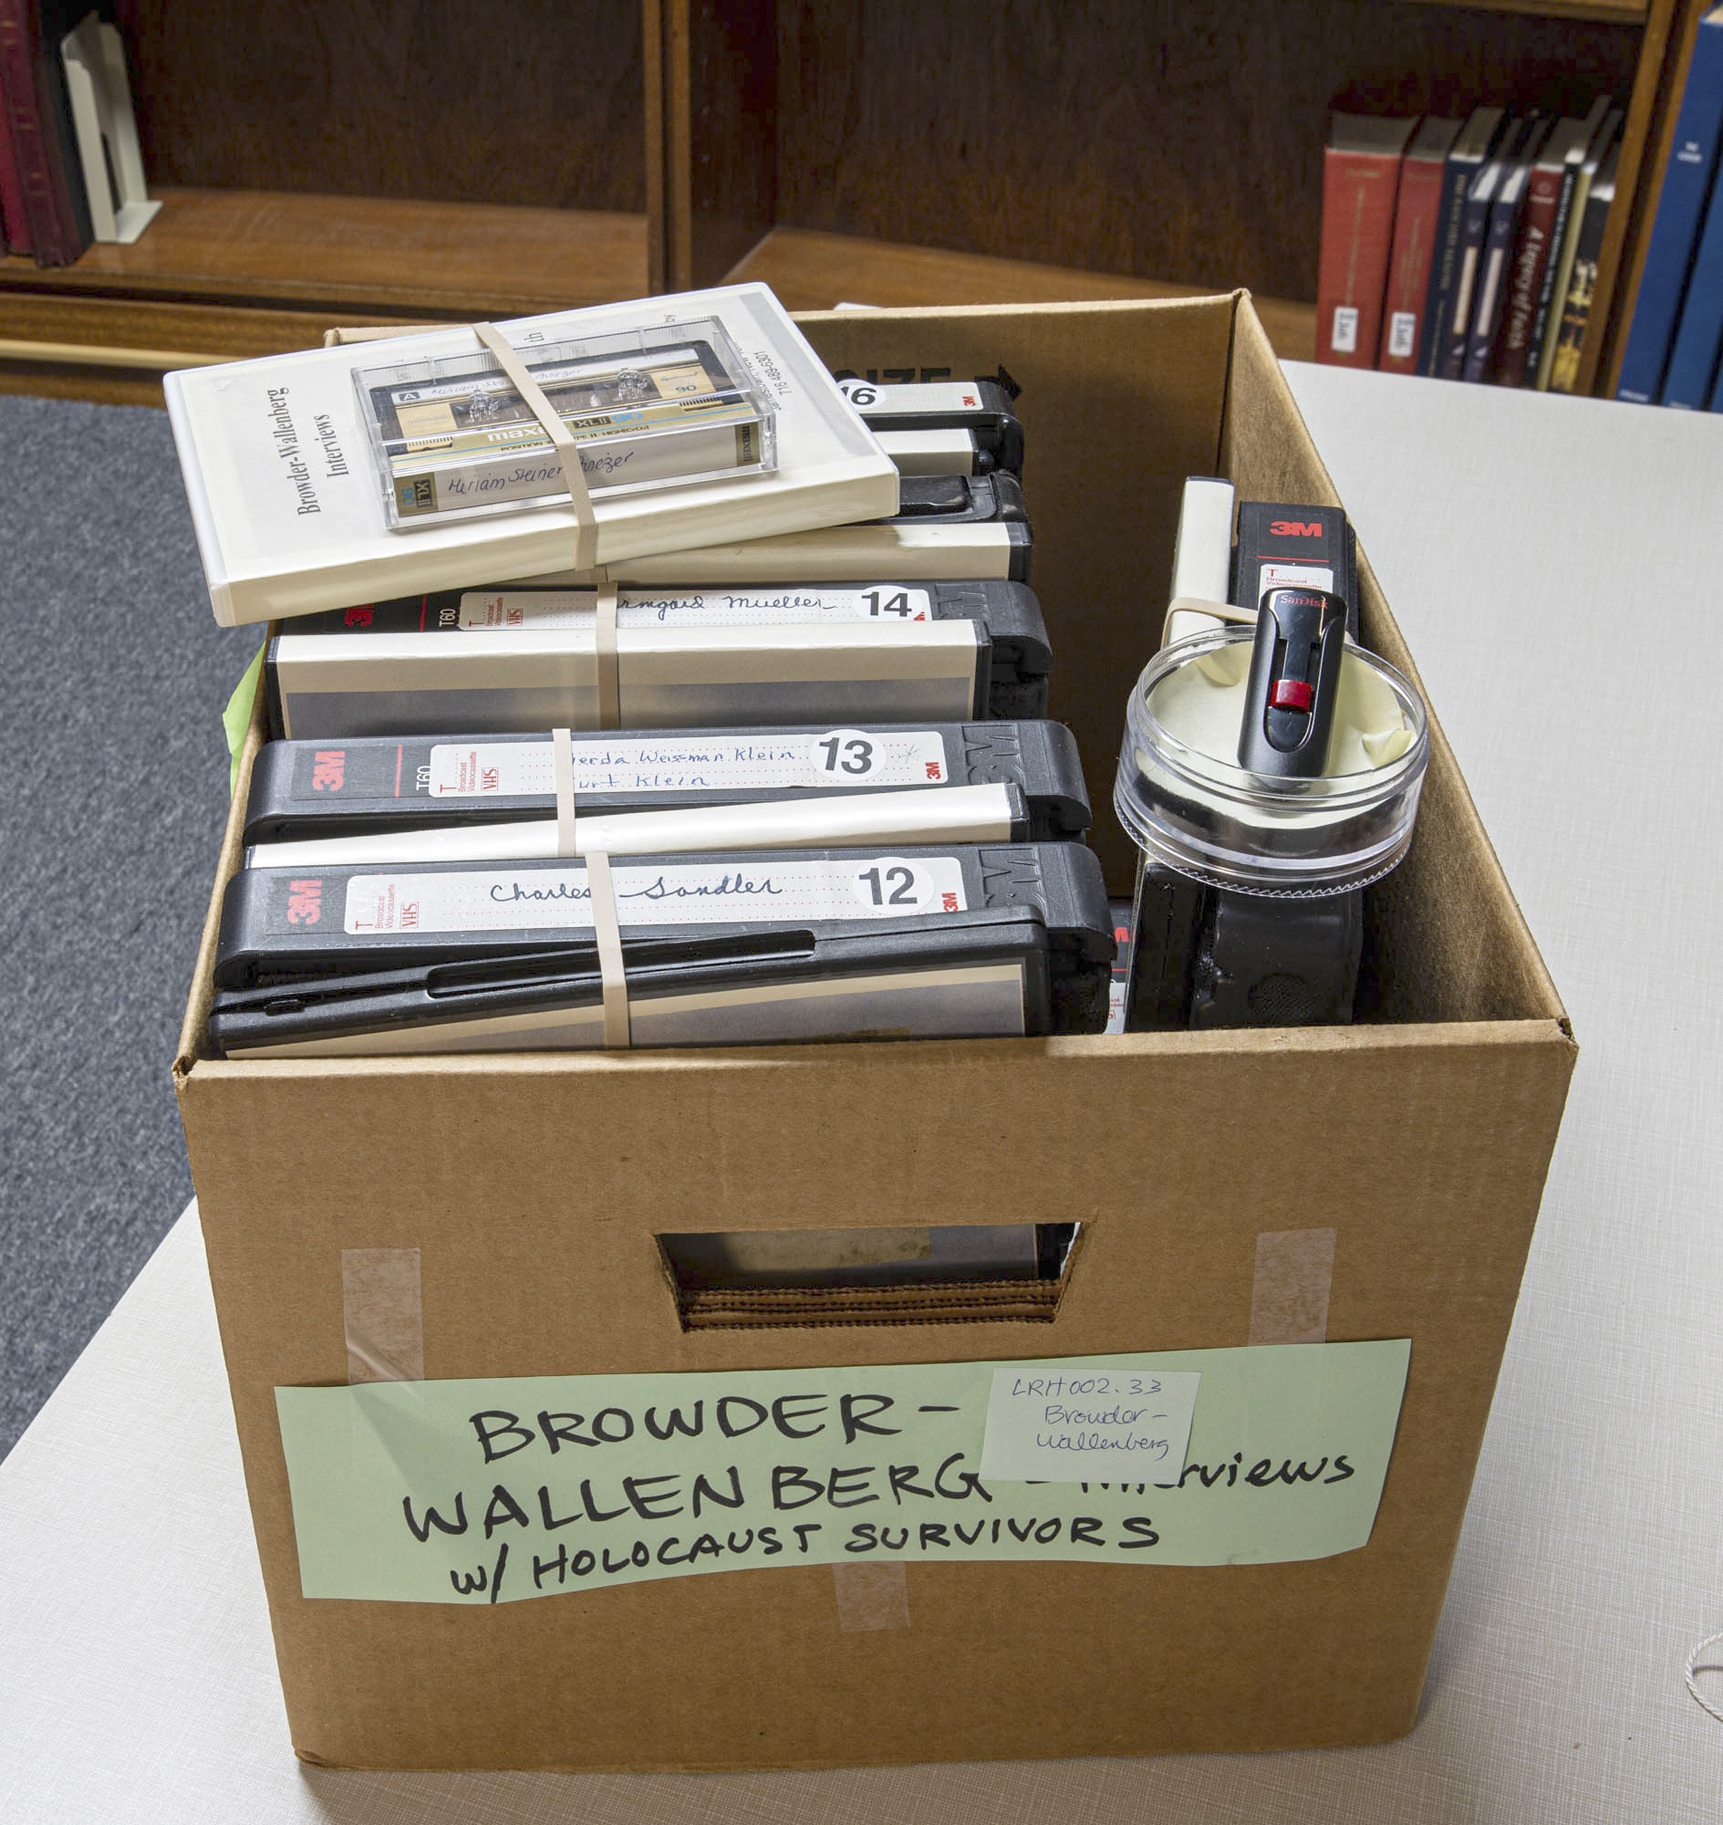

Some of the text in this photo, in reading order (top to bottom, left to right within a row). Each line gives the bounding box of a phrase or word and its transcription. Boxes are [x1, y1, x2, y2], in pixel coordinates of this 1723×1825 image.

[403, 393, 420, 401] A
[674, 384, 698, 393] 90
[962, 395, 977, 407] 3M
[611, 411, 643, 424] 90
[267, 386, 322, 517] Browder-Wallenberg
[313, 413, 350, 478] Interviews
[741, 425, 753, 462] maxell
[401, 486, 415, 506] 90
[1269, 520, 1323, 538] 3M
[1266, 568, 1279, 578] T
[617, 595, 705, 620] rmgard
[861, 591, 913, 618] 14
[1280, 594, 1329, 610] SanDisk
[438, 607, 457, 628] T60
[468, 619, 485, 628] T
[506, 608, 524, 627] VHS
[572, 751, 629, 765] erda
[736, 746, 795, 761] Klein
[818, 735, 873, 775] 13
[312, 751, 346, 793] 3M
[415, 765, 432, 792] T60
[458, 761, 468, 793] Broadcast
[482, 767, 498, 791] VHS
[578, 772, 709, 790] urt Klein
[925, 761, 942, 780] 3M
[439, 783, 457, 794] T
[490, 879, 592, 902] Charles
[858, 866, 919, 906] 12
[286, 879, 322, 926] 3M
[941, 892, 959, 912] 3M
[355, 919, 374, 931] T
[401, 901, 419, 929] VHS
[469, 1394, 903, 1465] BROWDER
[402, 1452, 993, 1542] WALLENBERG
[450, 1514, 1160, 1605] w/ HOLOCAUST SURVIVORS
